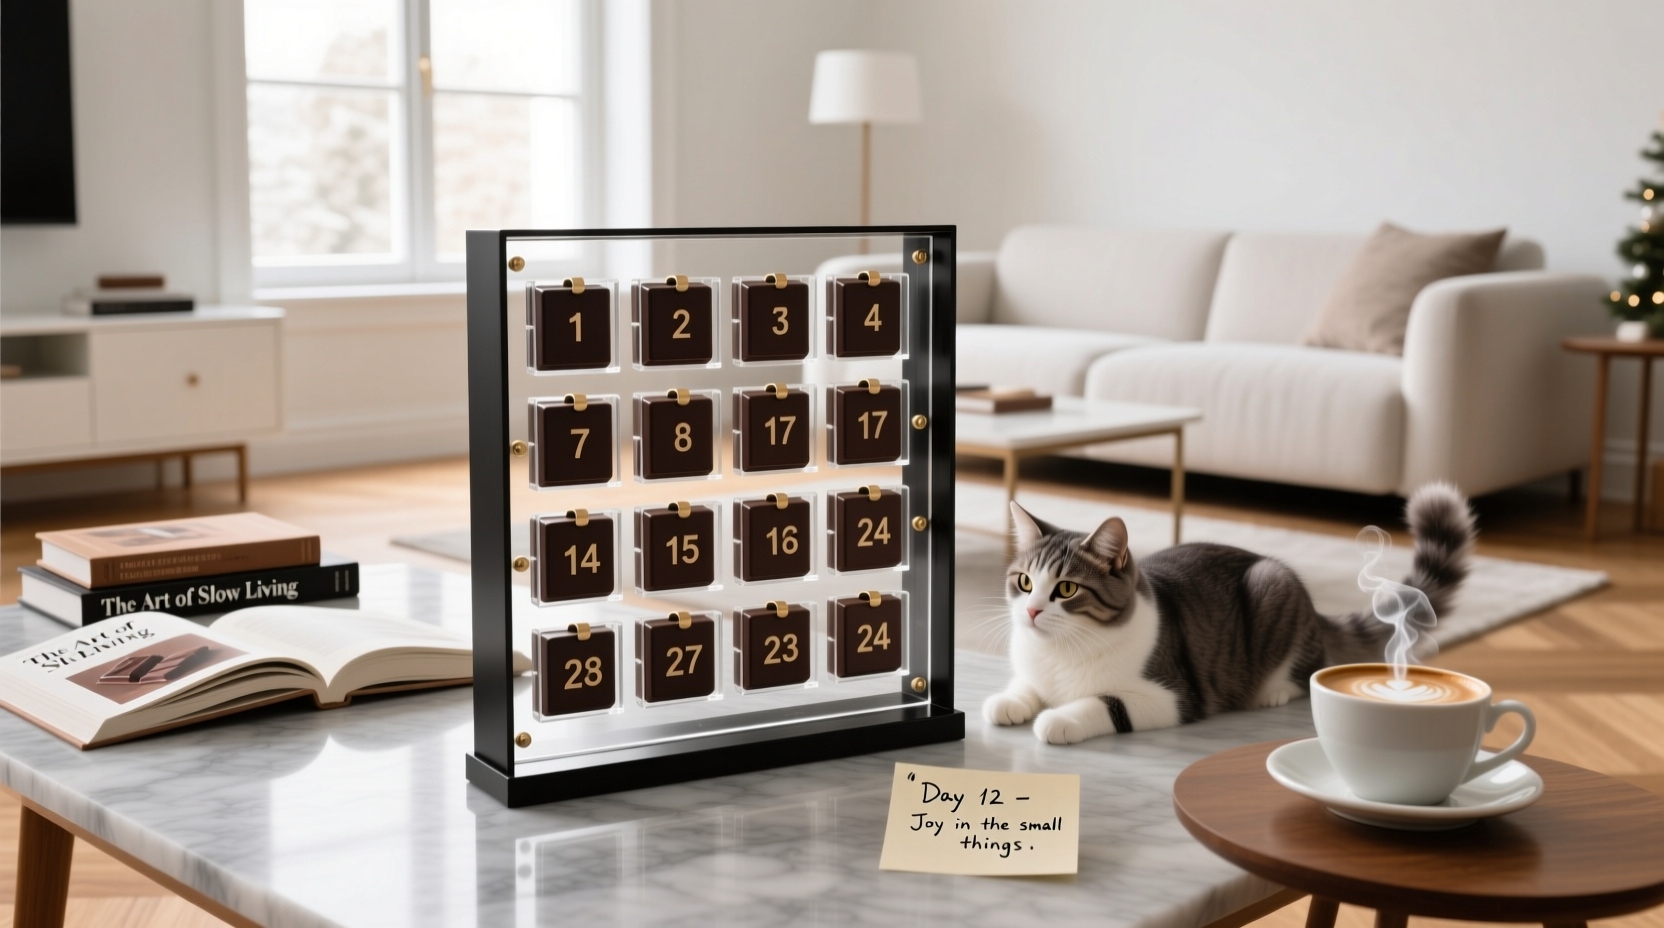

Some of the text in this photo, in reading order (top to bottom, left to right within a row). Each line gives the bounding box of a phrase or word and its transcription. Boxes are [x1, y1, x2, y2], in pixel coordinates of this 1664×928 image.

[568, 312, 582, 342] 1
[672, 308, 691, 339] 2
[772, 306, 789, 336] 3
[863, 303, 883, 332] 4
[674, 422, 693, 453] 8
[764, 415, 797, 446] 17
[857, 410, 888, 440] 17
[570, 428, 590, 459] 7
[766, 524, 799, 556] 16
[857, 516, 892, 548] 24
[564, 543, 601, 576] 14
[665, 534, 700, 566] 15
[101, 579, 299, 616] The Art of Slow Living
[763, 633, 799, 665] 23
[856, 621, 892, 654] 24
[564, 656, 603, 690] 28
[665, 644, 703, 678] 27
[979, 787, 1005, 806] 12
[910, 812, 1062, 837] Joy in the small
[959, 835, 1034, 859] things.
